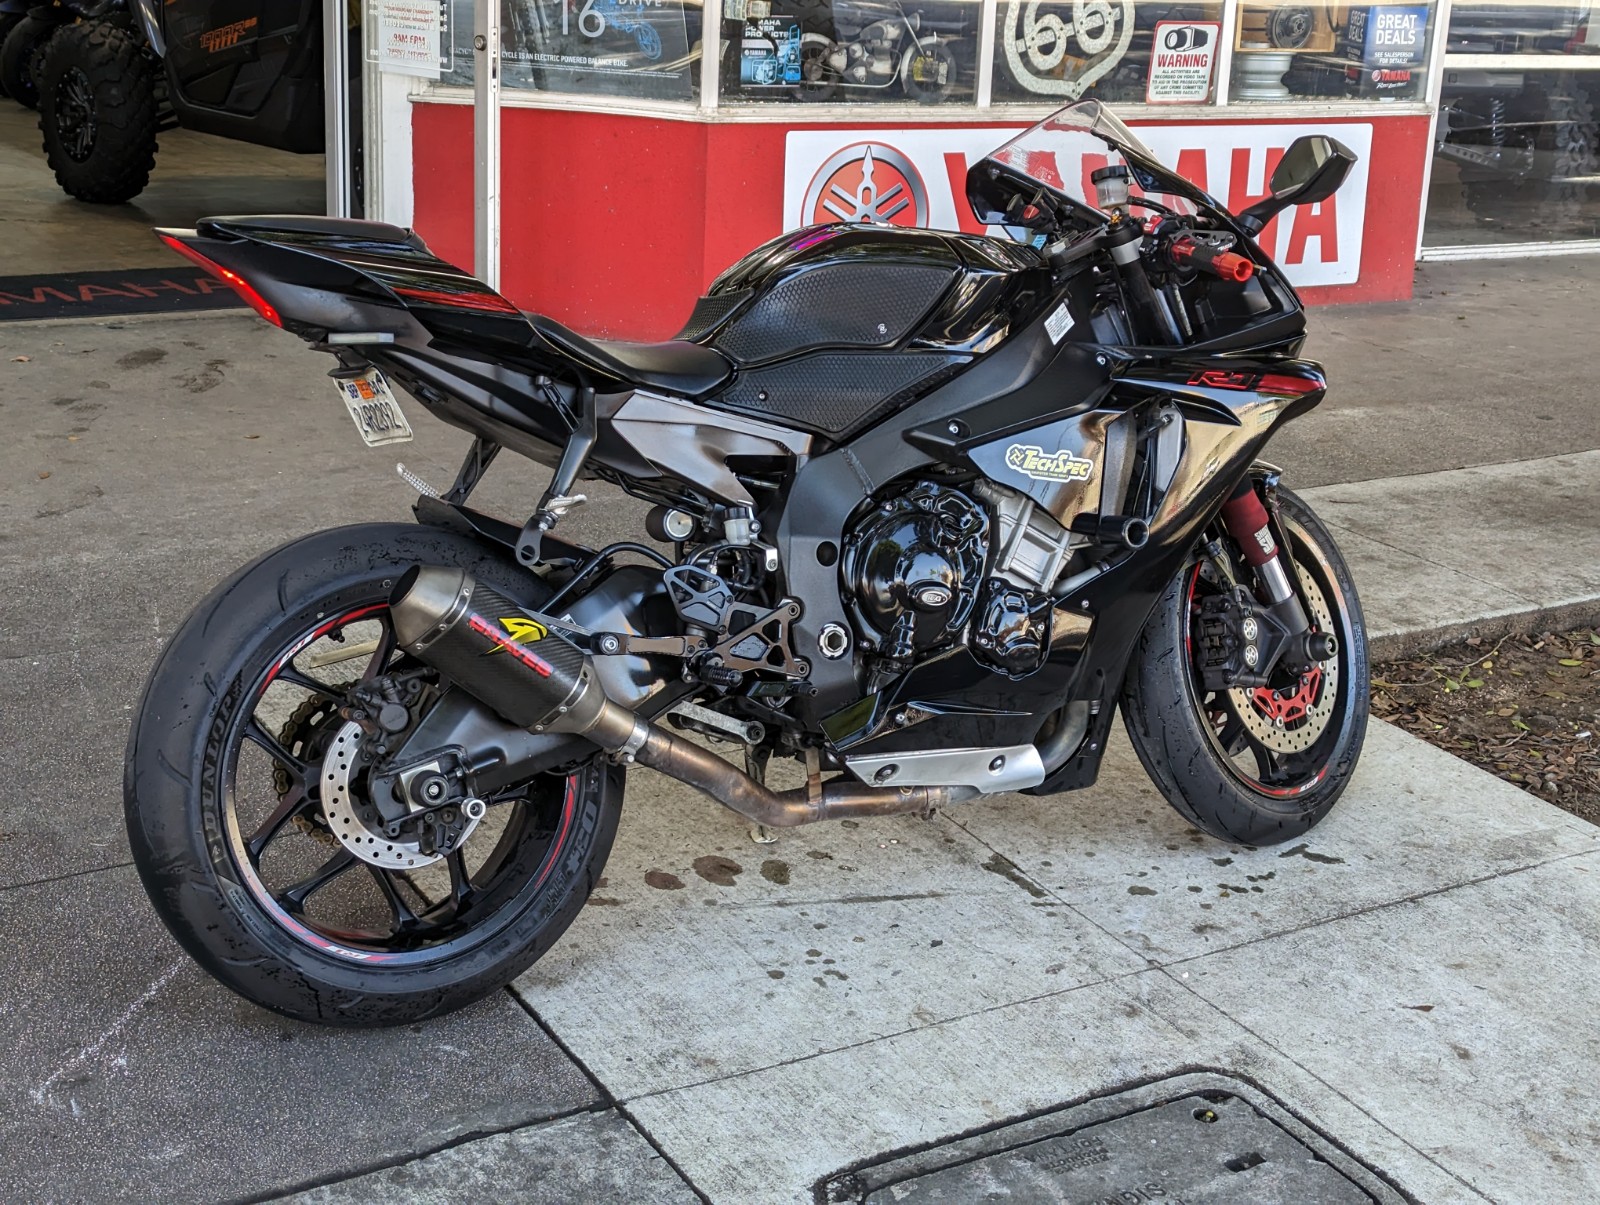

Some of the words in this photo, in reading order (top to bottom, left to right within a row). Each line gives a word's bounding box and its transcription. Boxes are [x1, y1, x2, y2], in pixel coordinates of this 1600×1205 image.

[562, 0, 606, 38] 16
[1377, 14, 1418, 29] GREAT
[1375, 30, 1416, 45] DEALS
[501, 51, 518, 59] CYCLE
[518, 52, 526, 60] IS
[525, 52, 534, 60] AN
[534, 53, 560, 62] ELECTRIC
[560, 55, 587, 64] POWERED
[587, 57, 612, 66] BALANCE
[612, 59, 629, 67] BIKE.
[1157, 53, 1208, 68] WARNING
[1380, 70, 1411, 82] YAMAHA
[204, 694, 238, 833] DUNLOP
